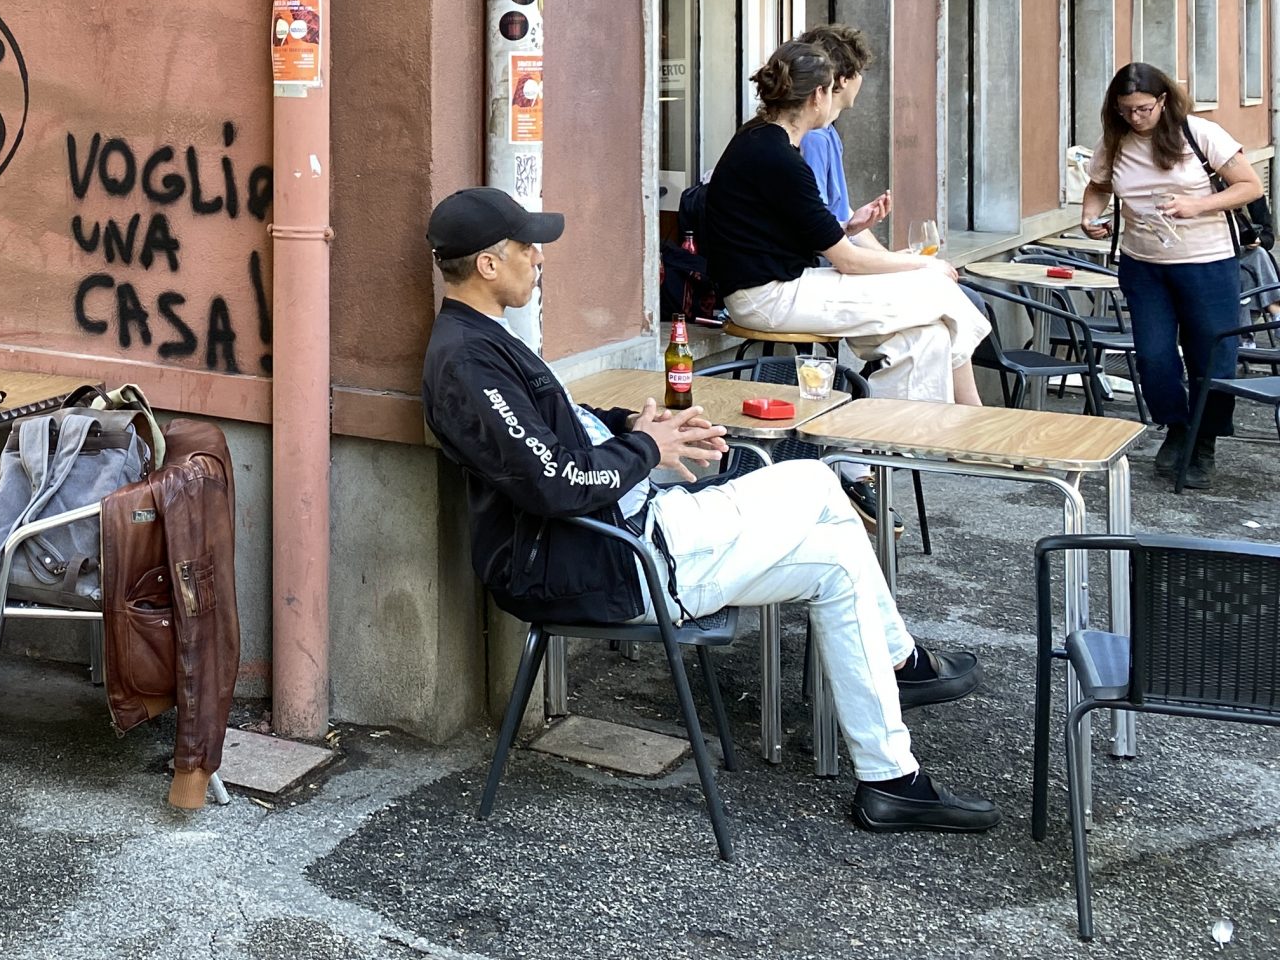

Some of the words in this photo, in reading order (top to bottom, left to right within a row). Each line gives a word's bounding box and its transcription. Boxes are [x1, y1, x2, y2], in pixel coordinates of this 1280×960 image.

[660, 63, 686, 77] ERTO
[72, 212, 180, 272] UNA
[668, 373, 692, 383] PERON
[482, 387, 526, 439] Center
[525, 436, 558, 478] Sace
